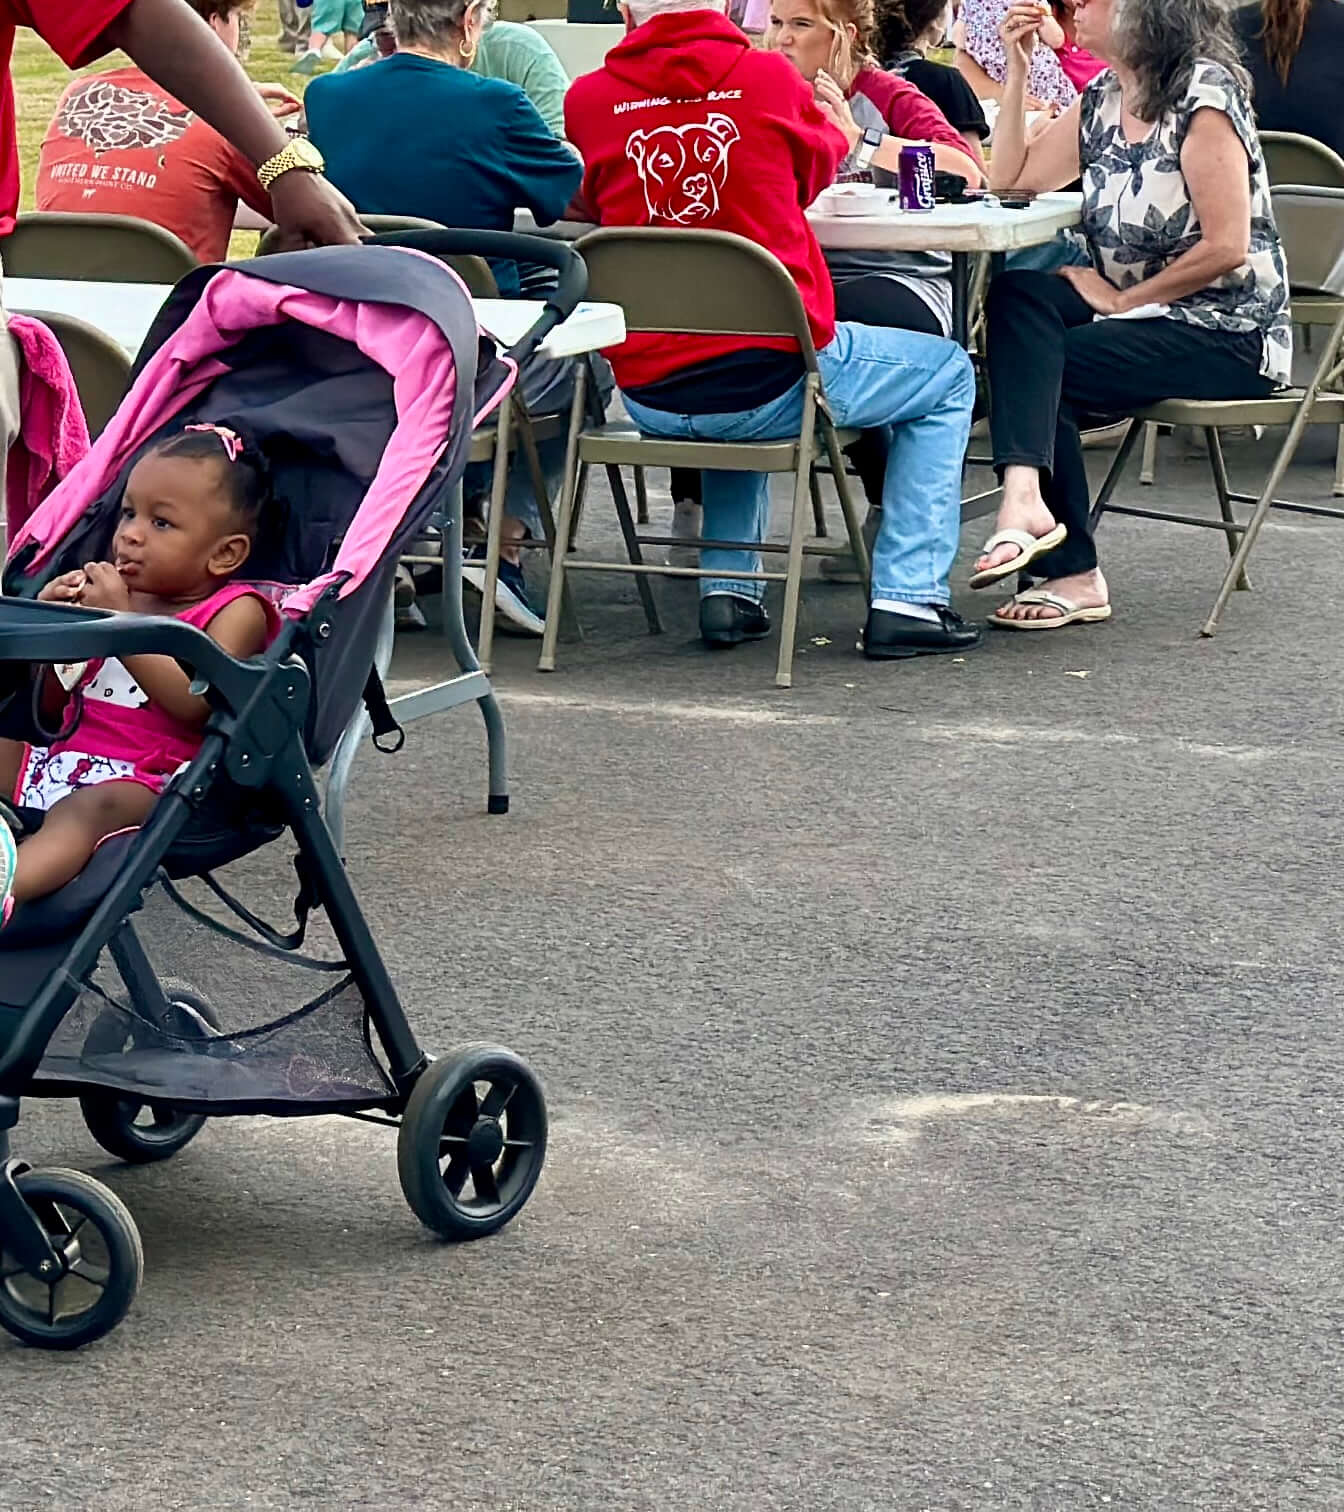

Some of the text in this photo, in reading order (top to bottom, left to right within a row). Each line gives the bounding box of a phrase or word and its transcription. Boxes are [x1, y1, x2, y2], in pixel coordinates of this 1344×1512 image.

[707, 89, 743, 102] RACE
[50, 162, 157, 189] UNITED WE STAND
